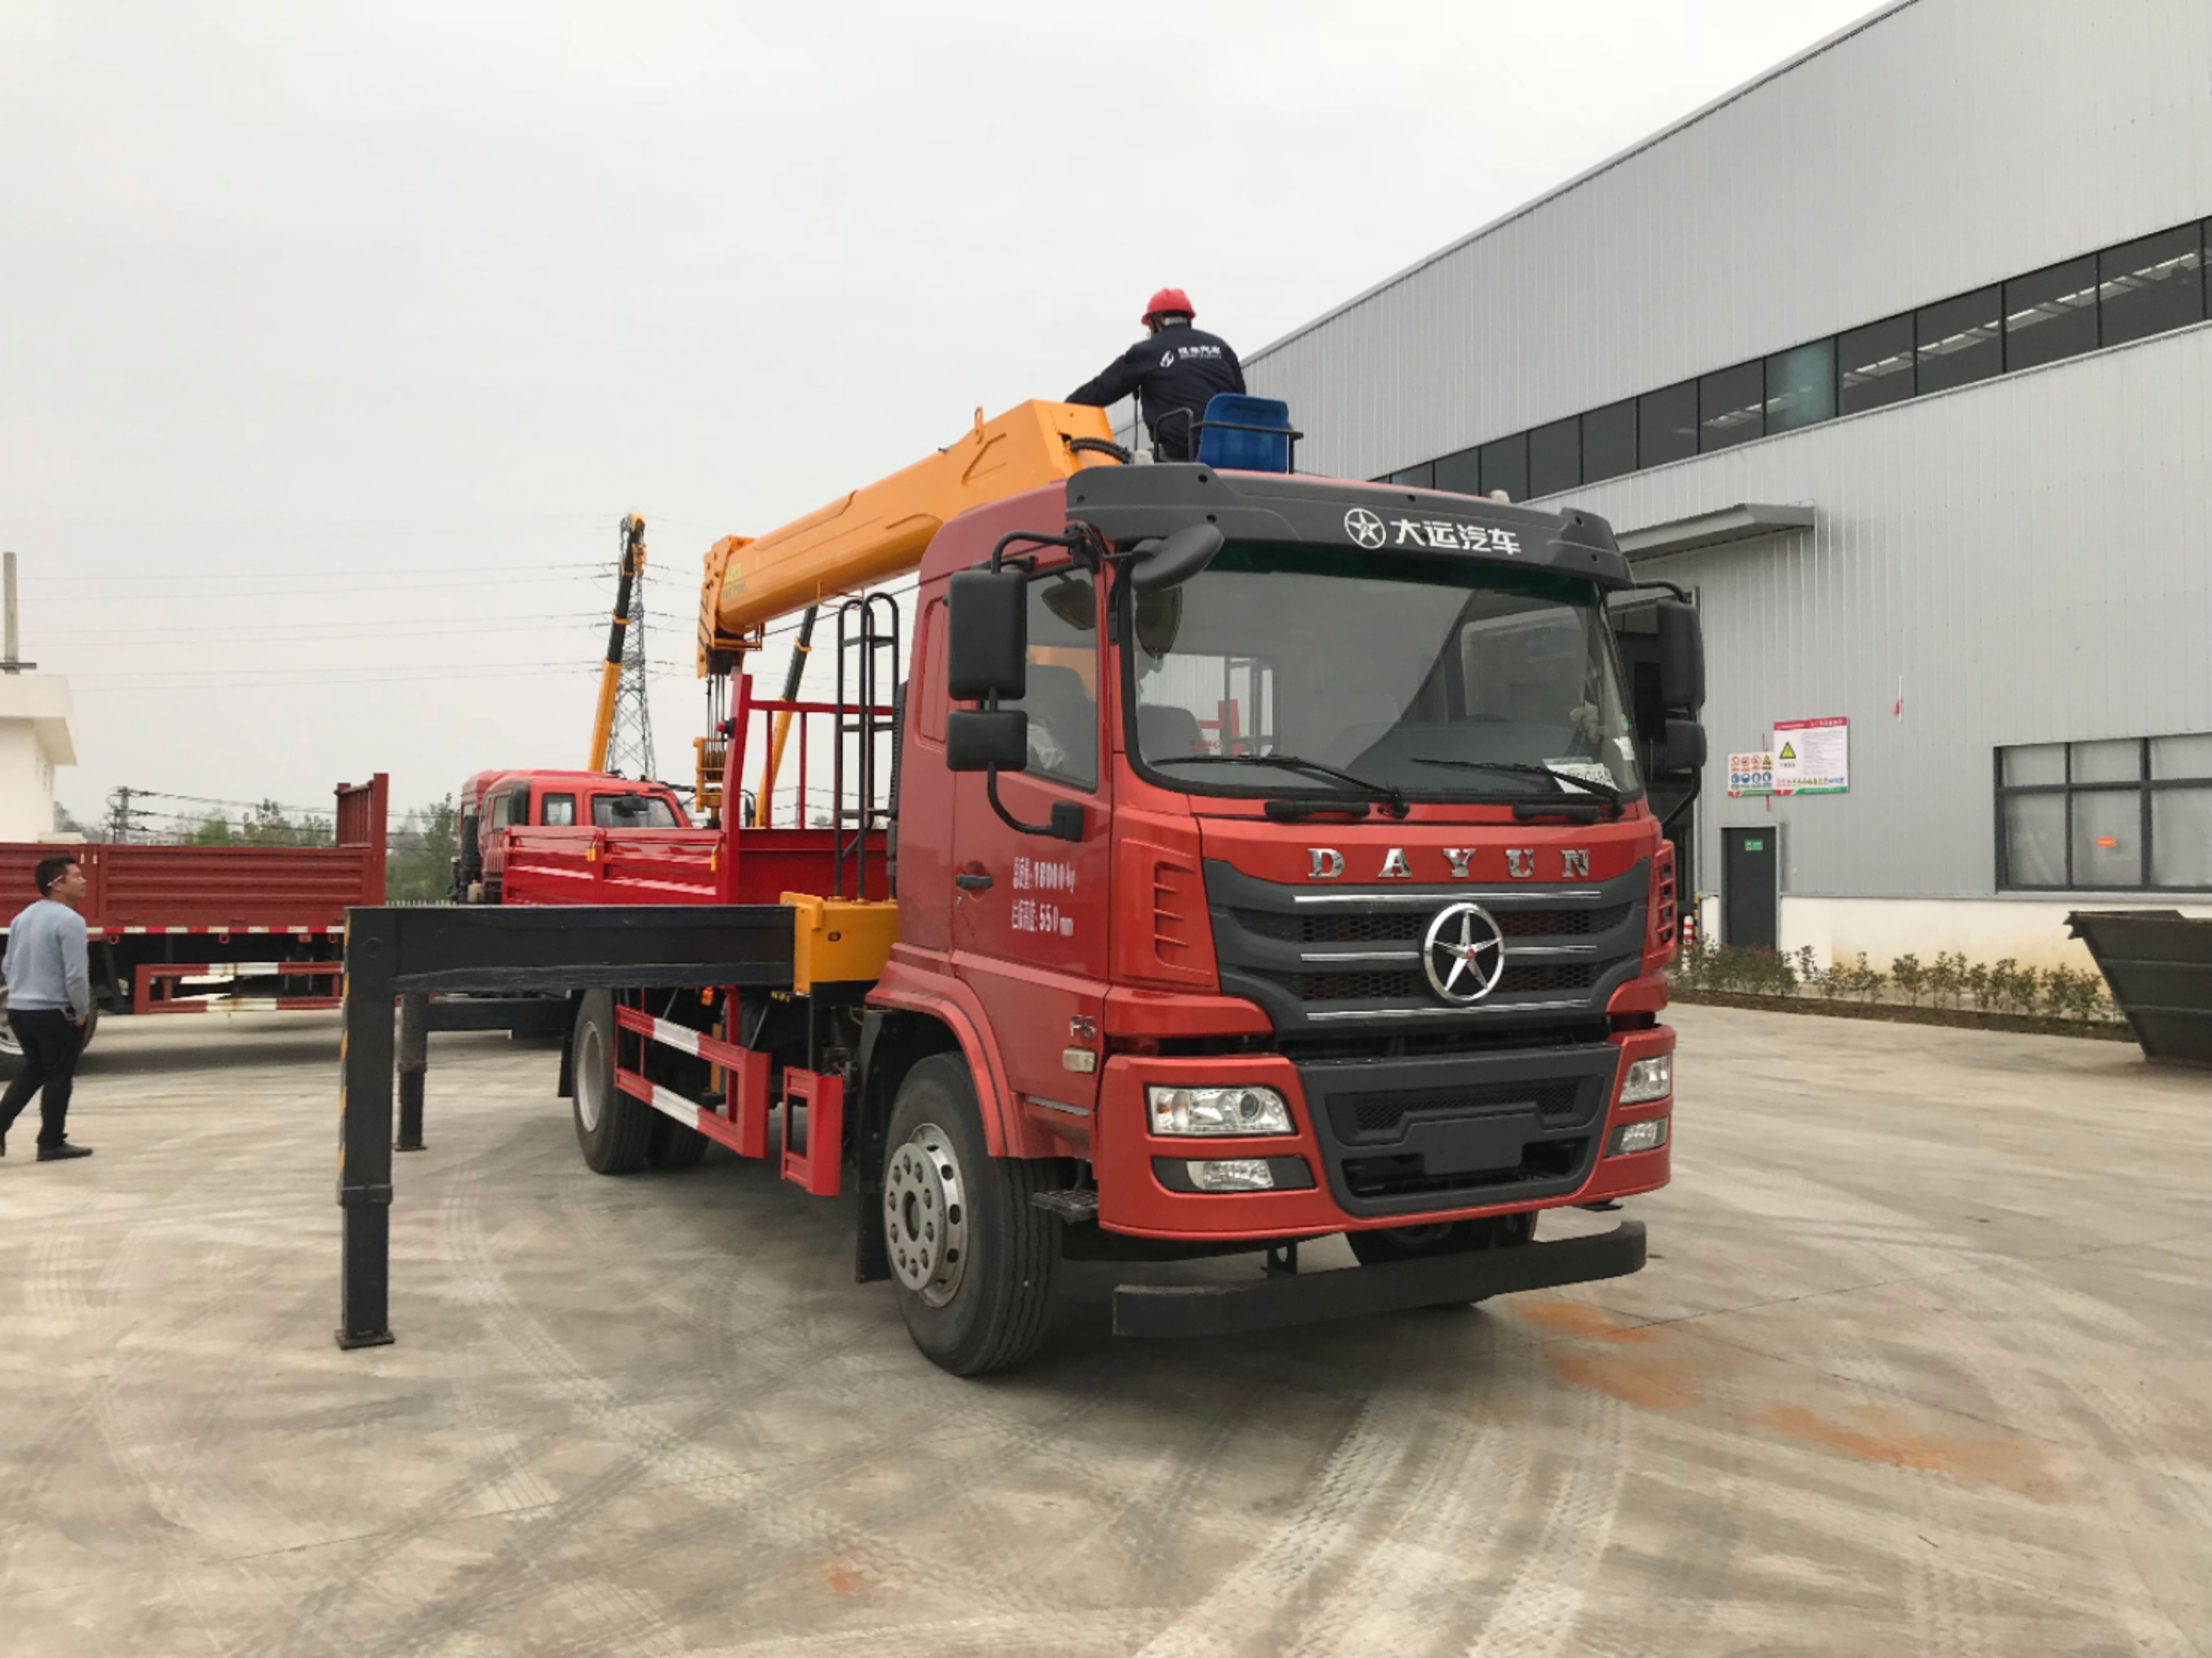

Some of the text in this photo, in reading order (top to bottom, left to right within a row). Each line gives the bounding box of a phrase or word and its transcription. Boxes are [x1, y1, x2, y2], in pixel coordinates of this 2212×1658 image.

[1390, 518, 1521, 555] 大运汽车
[1308, 848, 1590, 878] DAYUN
[1069, 1014, 1097, 1041] F6
